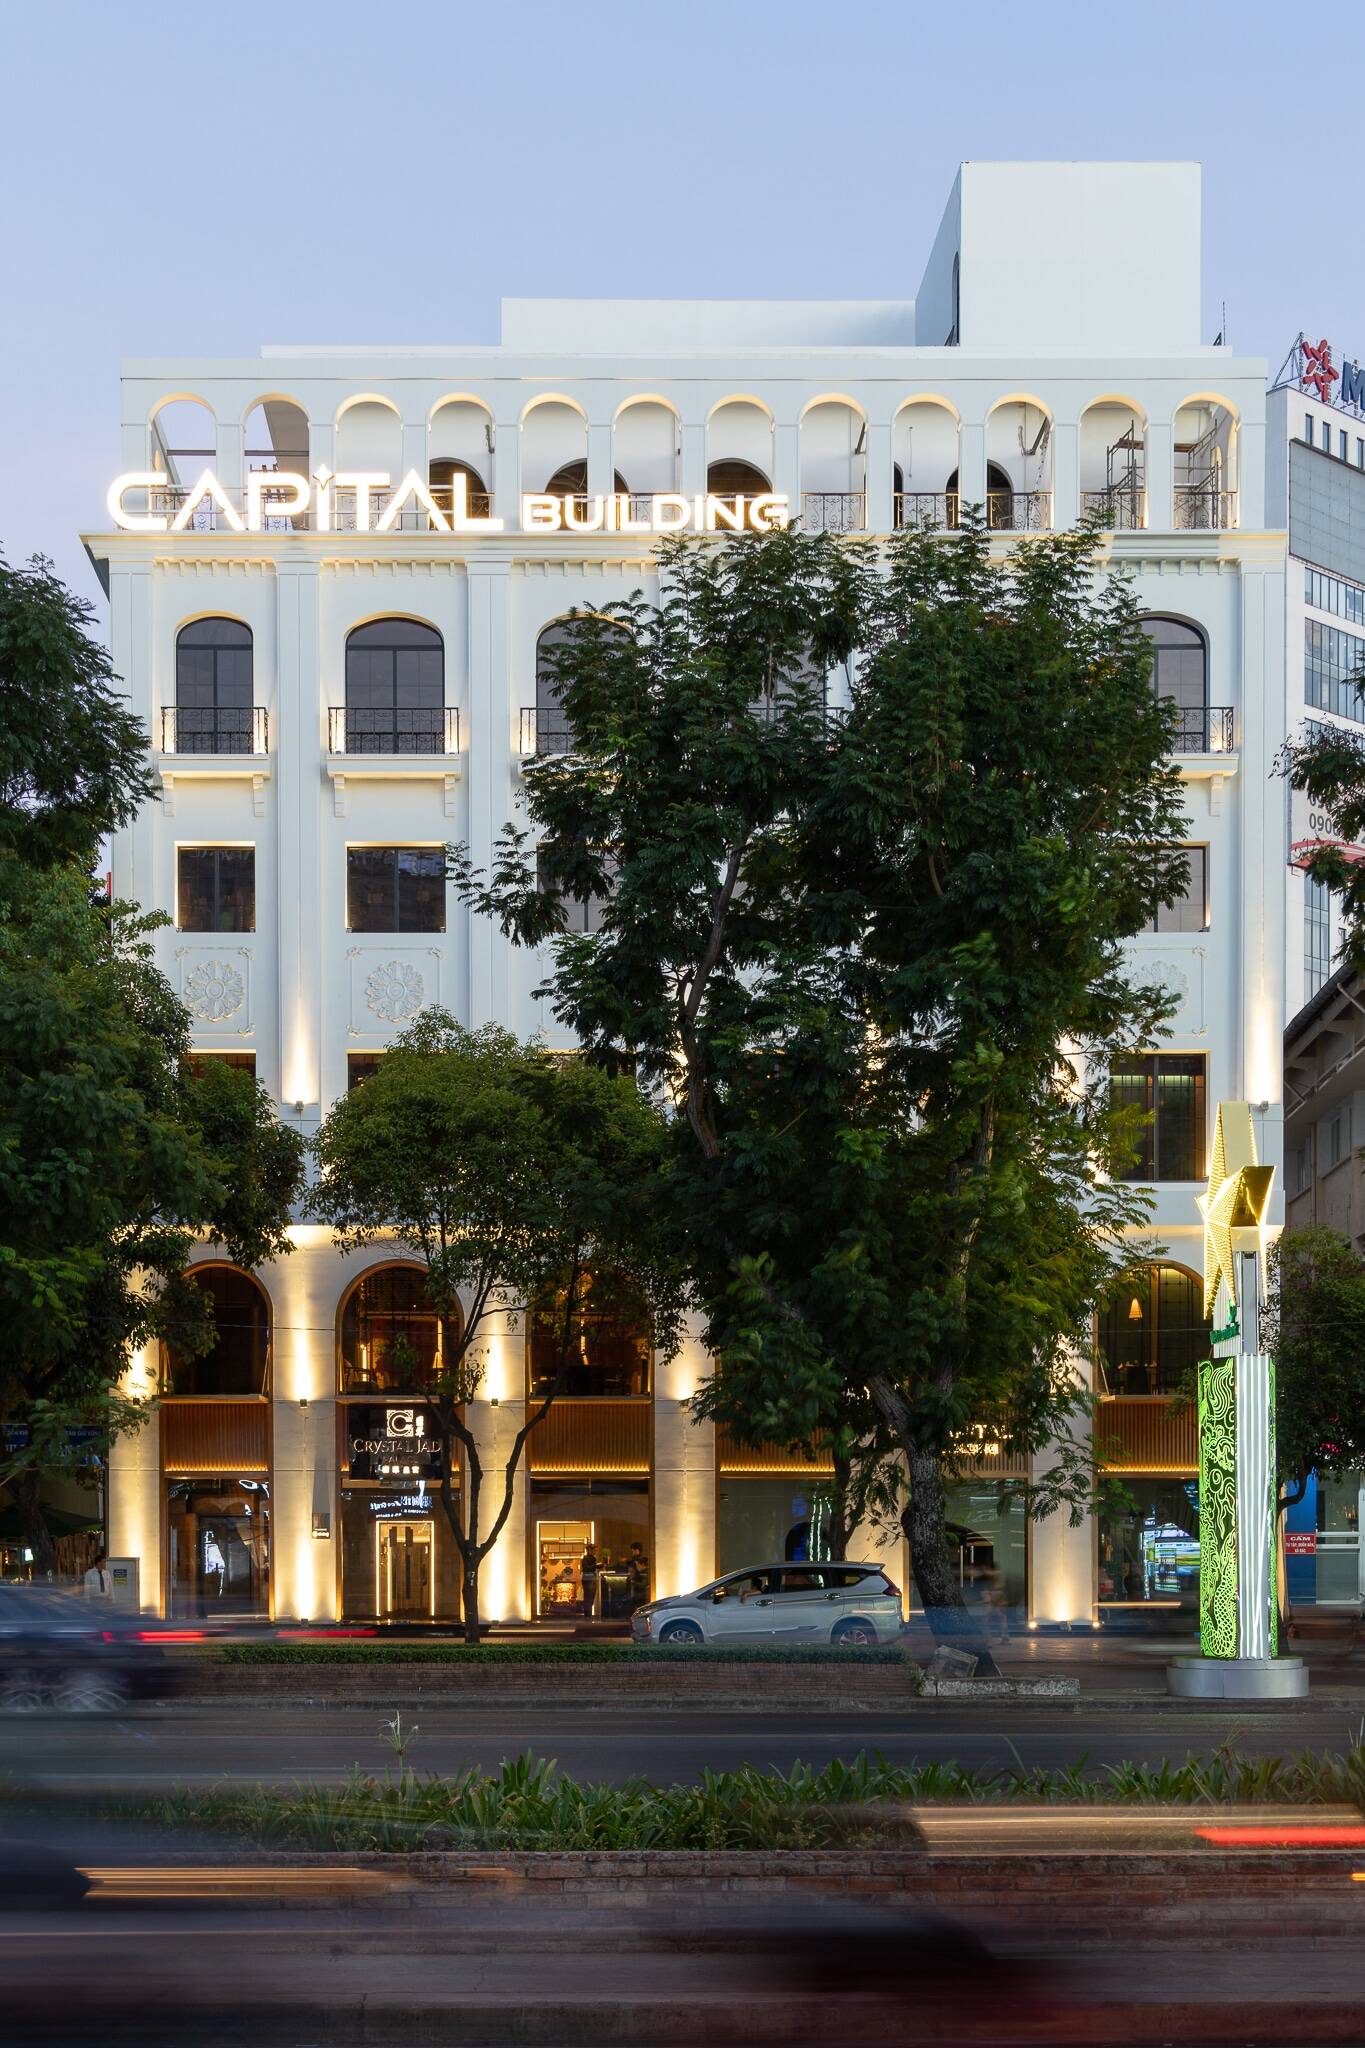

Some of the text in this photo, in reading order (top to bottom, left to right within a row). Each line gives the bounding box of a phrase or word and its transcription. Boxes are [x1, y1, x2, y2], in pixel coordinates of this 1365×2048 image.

[522, 494, 789, 531] BUILDING
[353, 1439, 441, 1454] CRYSTAL JAD
